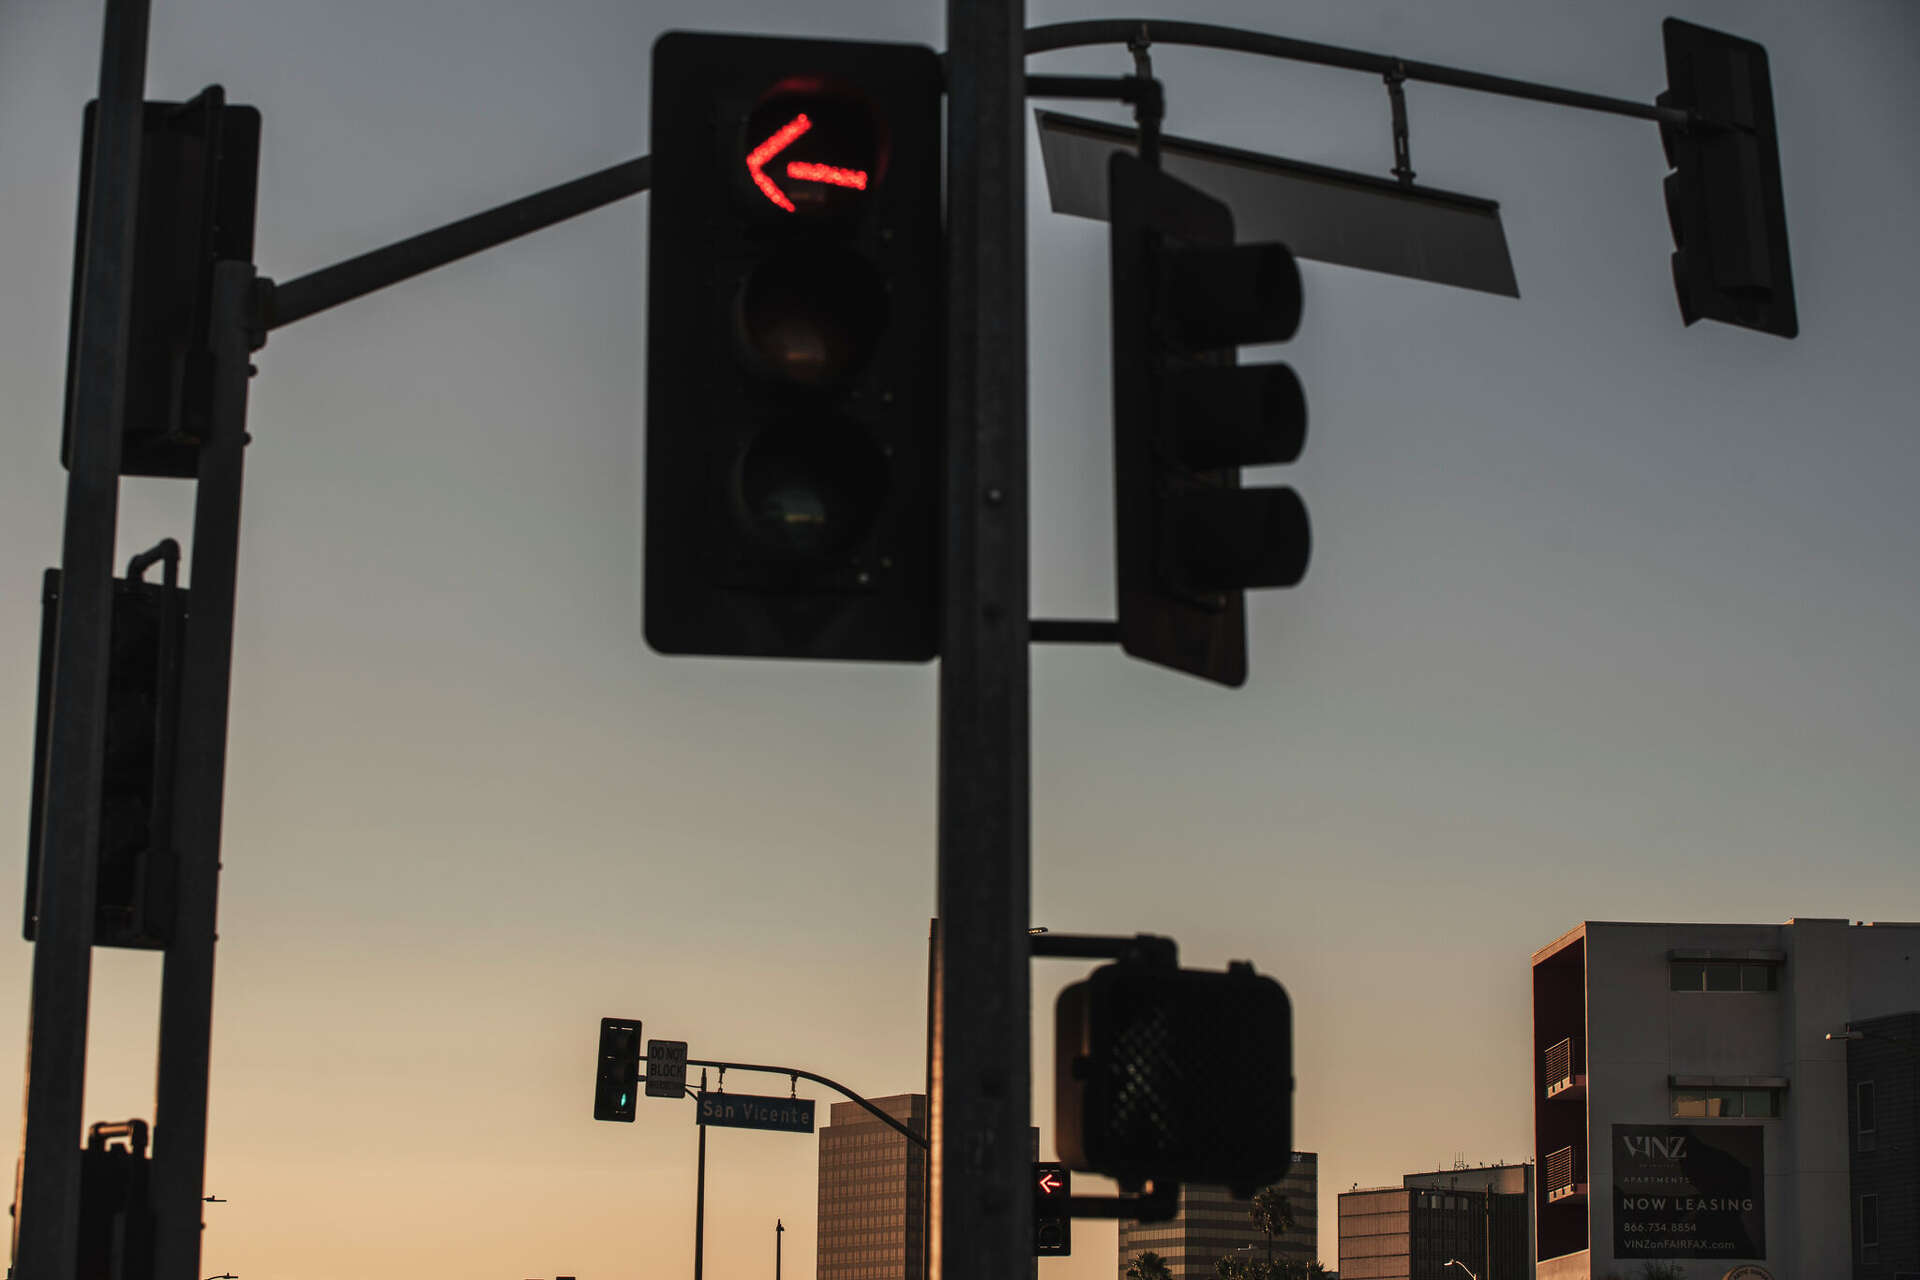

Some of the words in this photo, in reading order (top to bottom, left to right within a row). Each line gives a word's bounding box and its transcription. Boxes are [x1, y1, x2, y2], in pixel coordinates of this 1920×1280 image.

[650, 1046, 665, 1060] DO
[666, 1047, 684, 1061] NOT
[650, 1063, 684, 1078] BLOCK
[703, 1100, 735, 1119] San
[743, 1103, 810, 1125] Vicente
[1623, 1135, 1688, 1160] VINZ
[1623, 1176, 1691, 1184] APARTMENTS
[1623, 1198, 1667, 1211] NOW
[1675, 1198, 1754, 1212] LEASING
[1623, 1222, 1697, 1233] 866.734.8854
[1623, 1239, 1736, 1249] VINZonFAIRFAX.com
